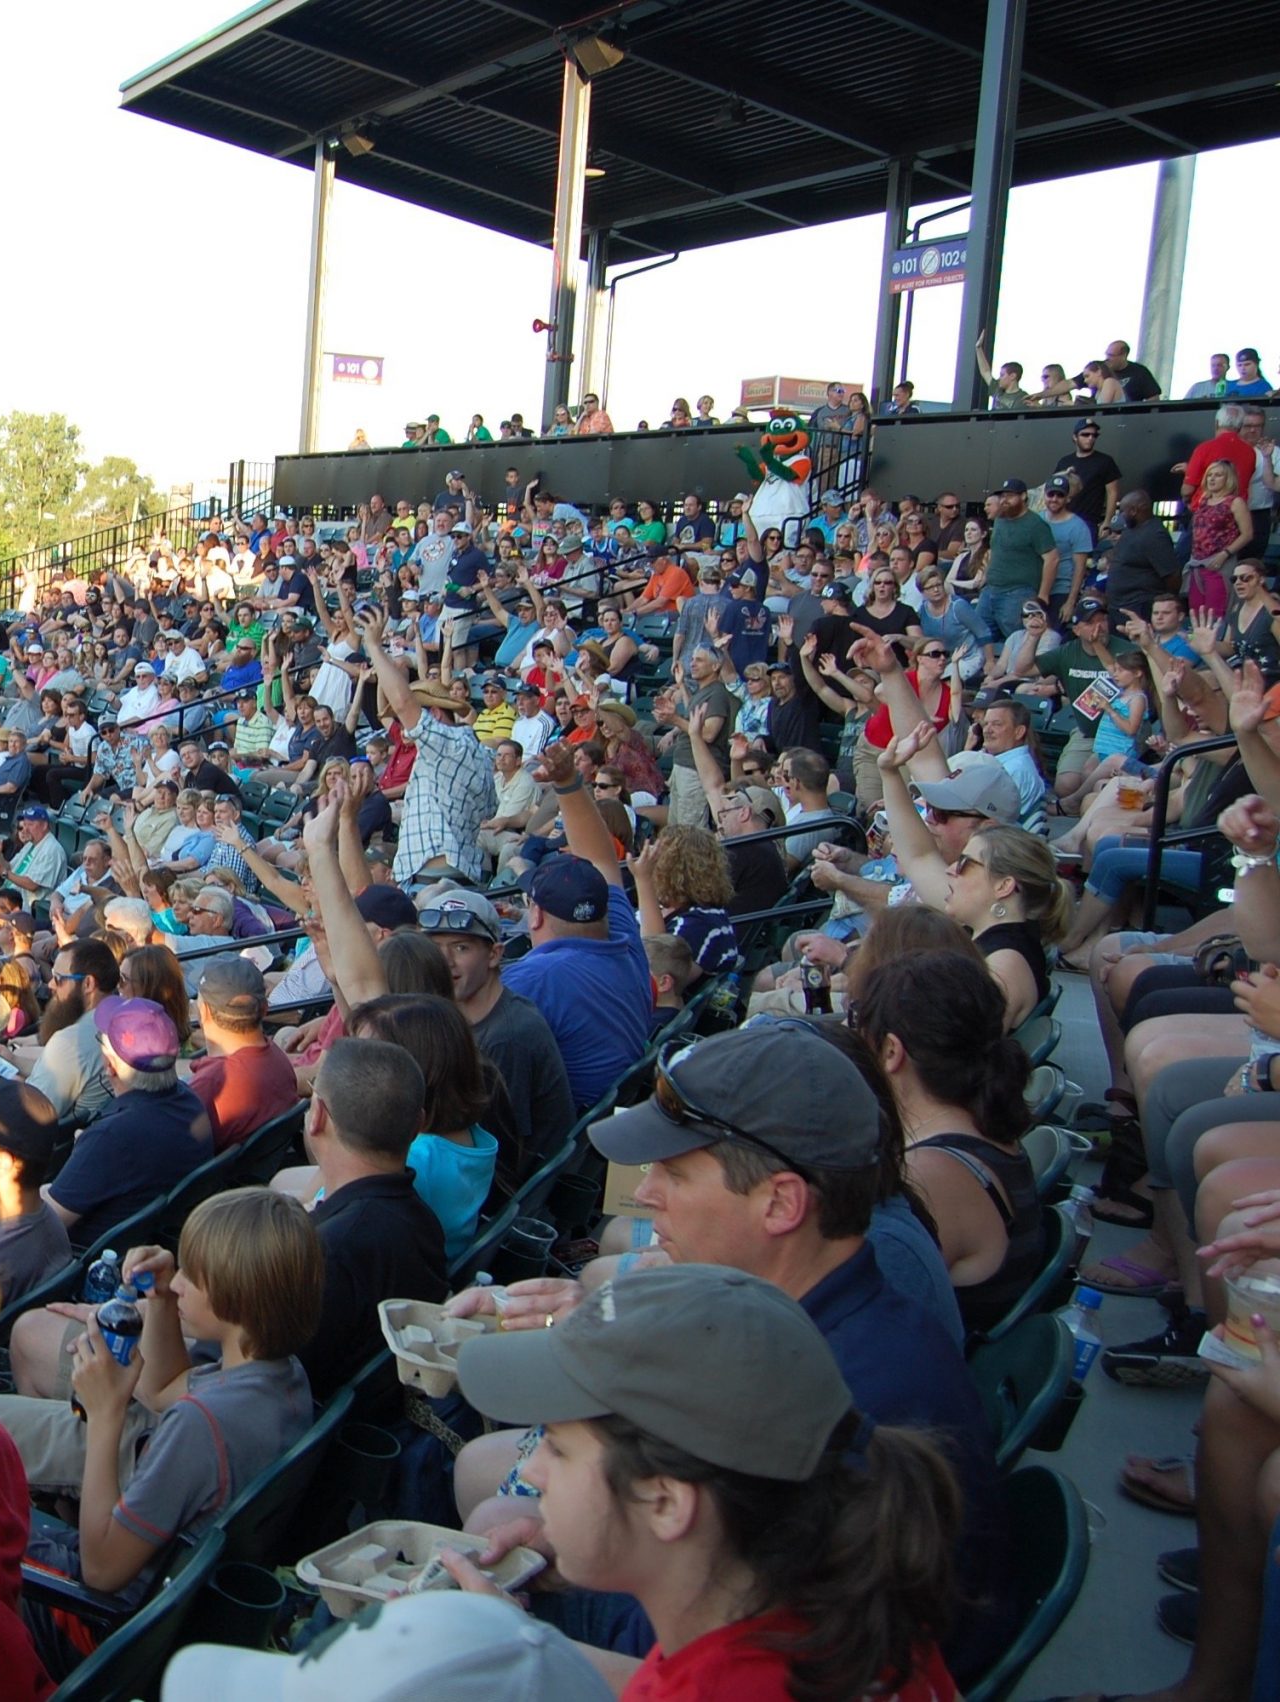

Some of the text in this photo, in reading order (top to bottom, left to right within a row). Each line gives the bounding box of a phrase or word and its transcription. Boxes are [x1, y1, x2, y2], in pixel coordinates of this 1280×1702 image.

[901, 250, 960, 275] 101 102
[347, 362, 360, 375] 101
